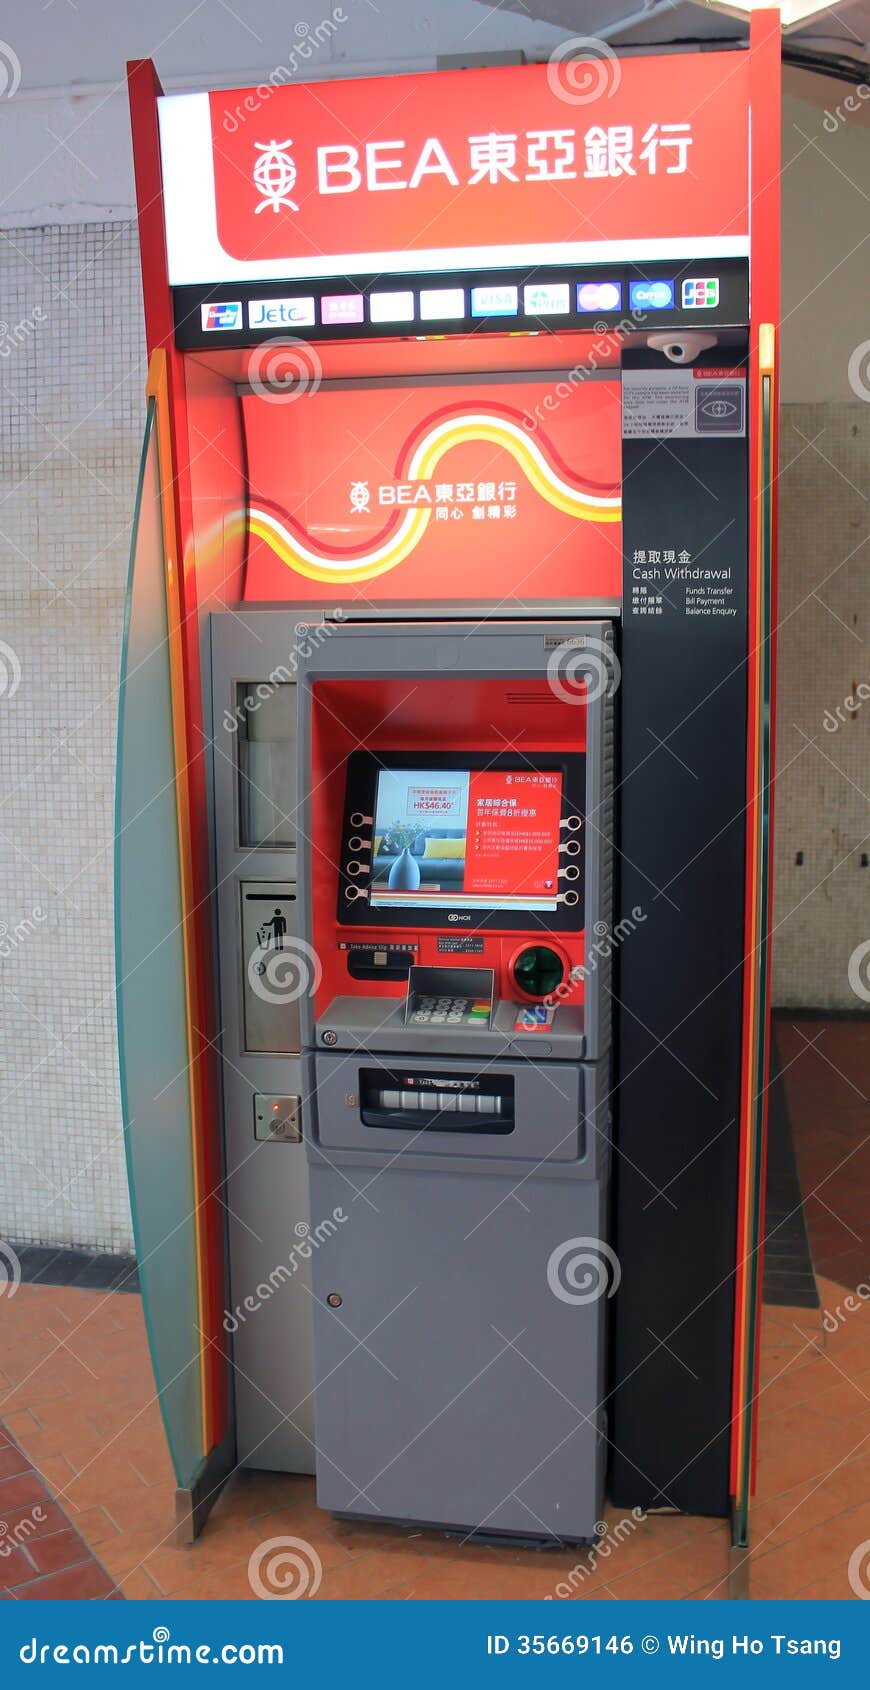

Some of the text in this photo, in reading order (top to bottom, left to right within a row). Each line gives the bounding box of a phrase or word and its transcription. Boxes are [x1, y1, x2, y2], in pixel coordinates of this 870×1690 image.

[316, 123, 694, 195] BEA 東亞銀行
[378, 481, 517, 505] BEA 東亞銀行
[435, 506, 465, 521] 同心
[633, 549, 691, 564] 提取現金
[632, 567, 731, 580] Cash Withdrawal
[685, 586, 733, 595] Funds Transfer
[685, 597, 725, 606] Bill Payment
[685, 607, 737, 616] Balance Enquiry
